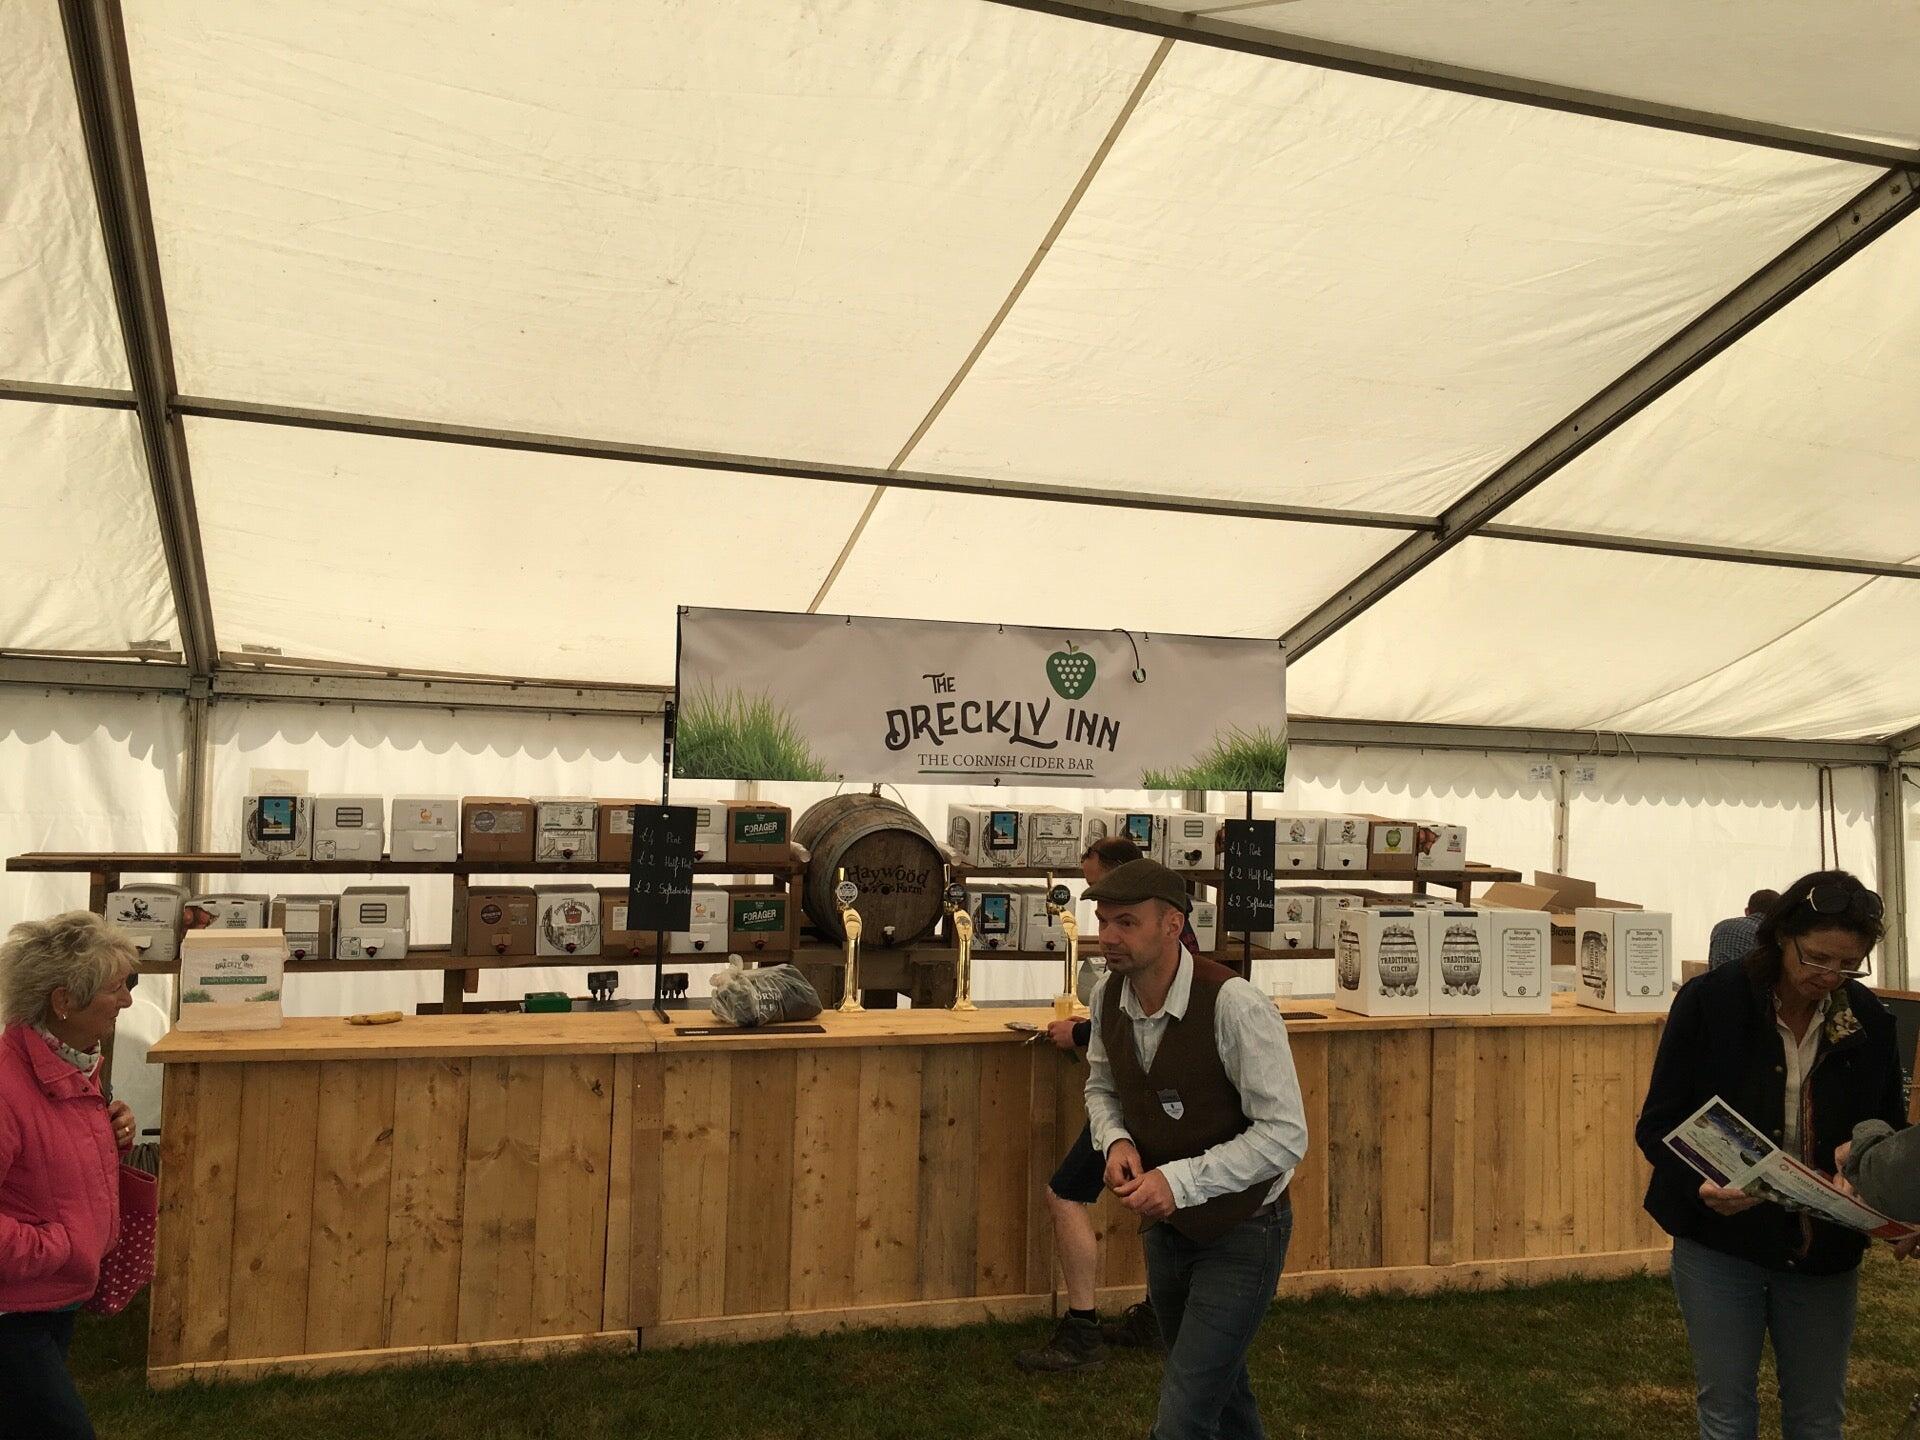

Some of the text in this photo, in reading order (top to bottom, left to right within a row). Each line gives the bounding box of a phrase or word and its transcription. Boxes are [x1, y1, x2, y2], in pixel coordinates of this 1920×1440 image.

[922, 673, 956, 694] THE
[885, 697, 1121, 752] DRECKLY INN
[918, 753, 1094, 771] THE CORNISH CIDER BAR
[744, 821, 778, 834] FORAGER
[743, 909, 777, 921] FORAGER
[1381, 955, 1418, 965] TRADITIONAL
[1443, 955, 1480, 964] TRADITIONAL
[1390, 965, 1408, 973] CIDER
